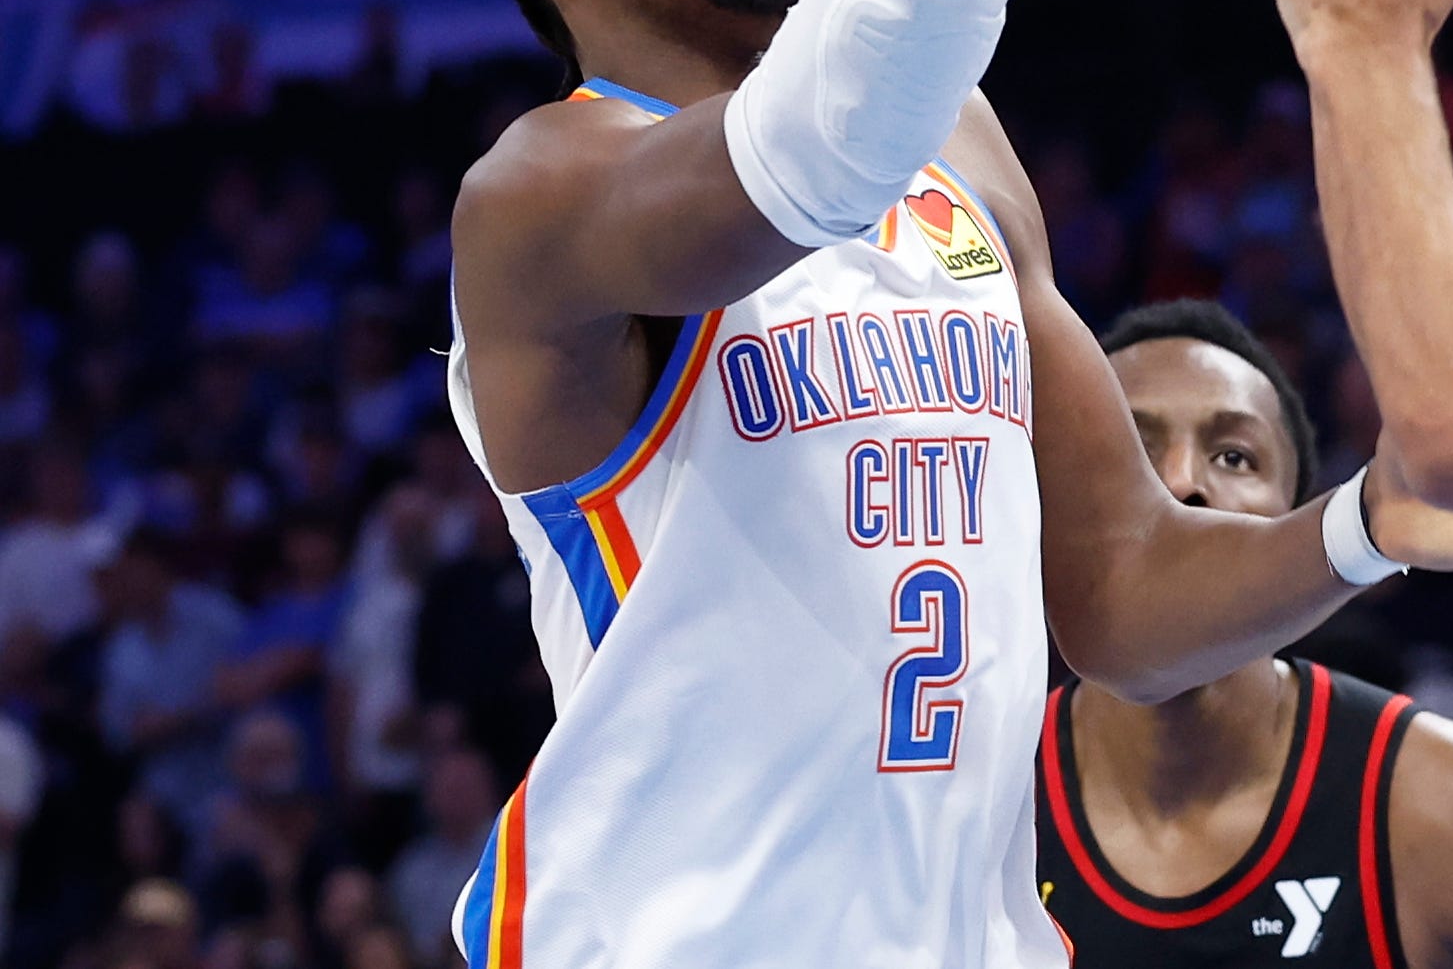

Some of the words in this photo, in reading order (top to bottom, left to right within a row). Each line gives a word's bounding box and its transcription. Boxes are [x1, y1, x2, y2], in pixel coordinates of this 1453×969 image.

[719, 309, 1034, 442] OKLAHOM
[846, 437, 990, 549] CITY
[877, 560, 968, 773] 2
[1251, 916, 1284, 937] the
[1274, 876, 1341, 958] Y
